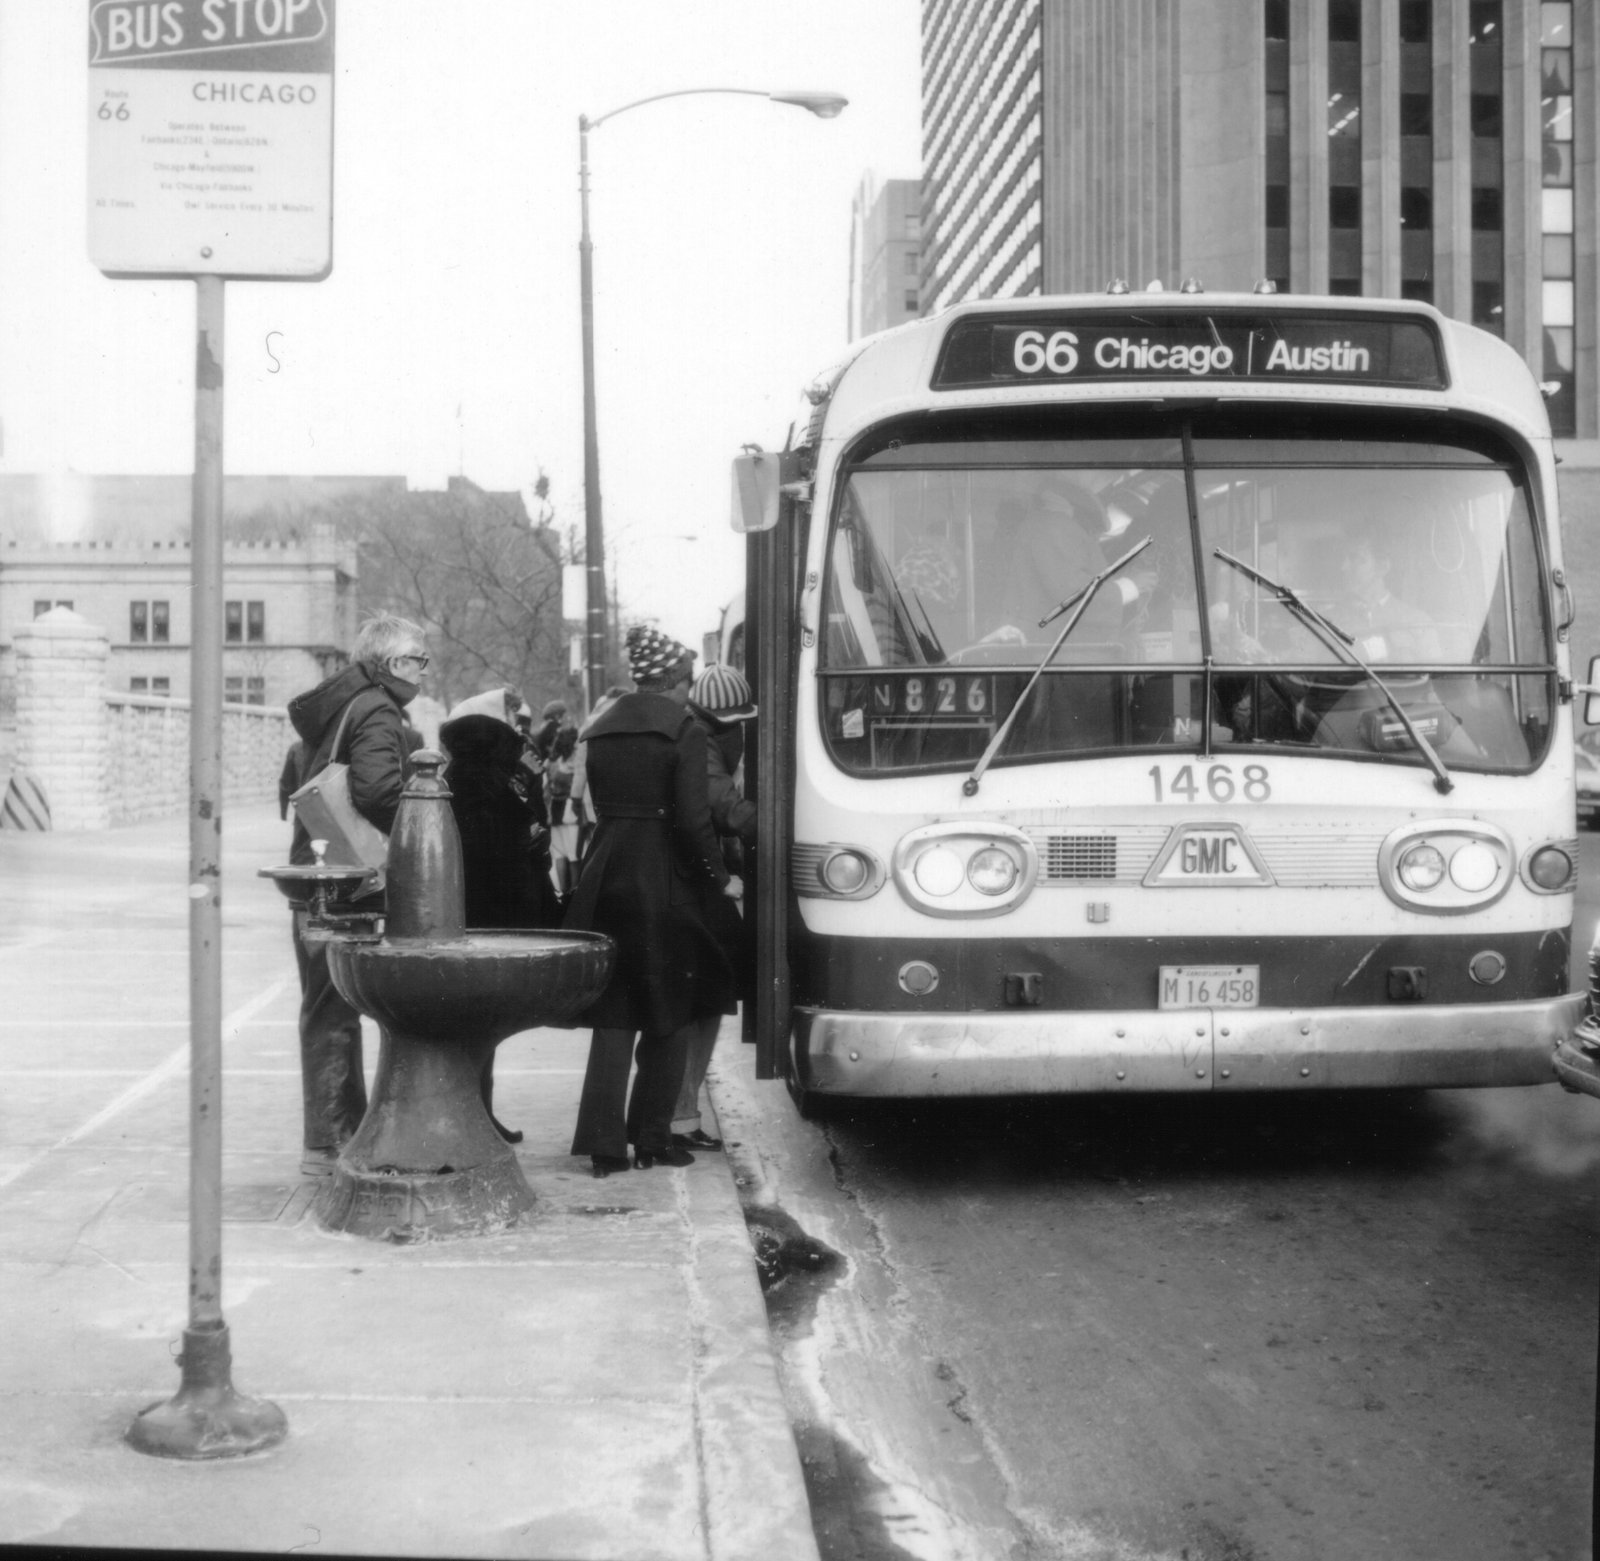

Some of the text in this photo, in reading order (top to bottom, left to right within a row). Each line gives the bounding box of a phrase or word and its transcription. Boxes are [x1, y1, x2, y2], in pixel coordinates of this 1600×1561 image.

[107, 0, 310, 51] BUS STOP
[192, 81, 316, 104] CHICAGO
[97, 101, 131, 122] 66
[1013, 330, 1370, 375] 66 Chicago Austin
[1148, 764, 1272, 803] 1468
[1181, 837, 1237, 874] GMC
[1164, 978, 1255, 1003] M 16 458
